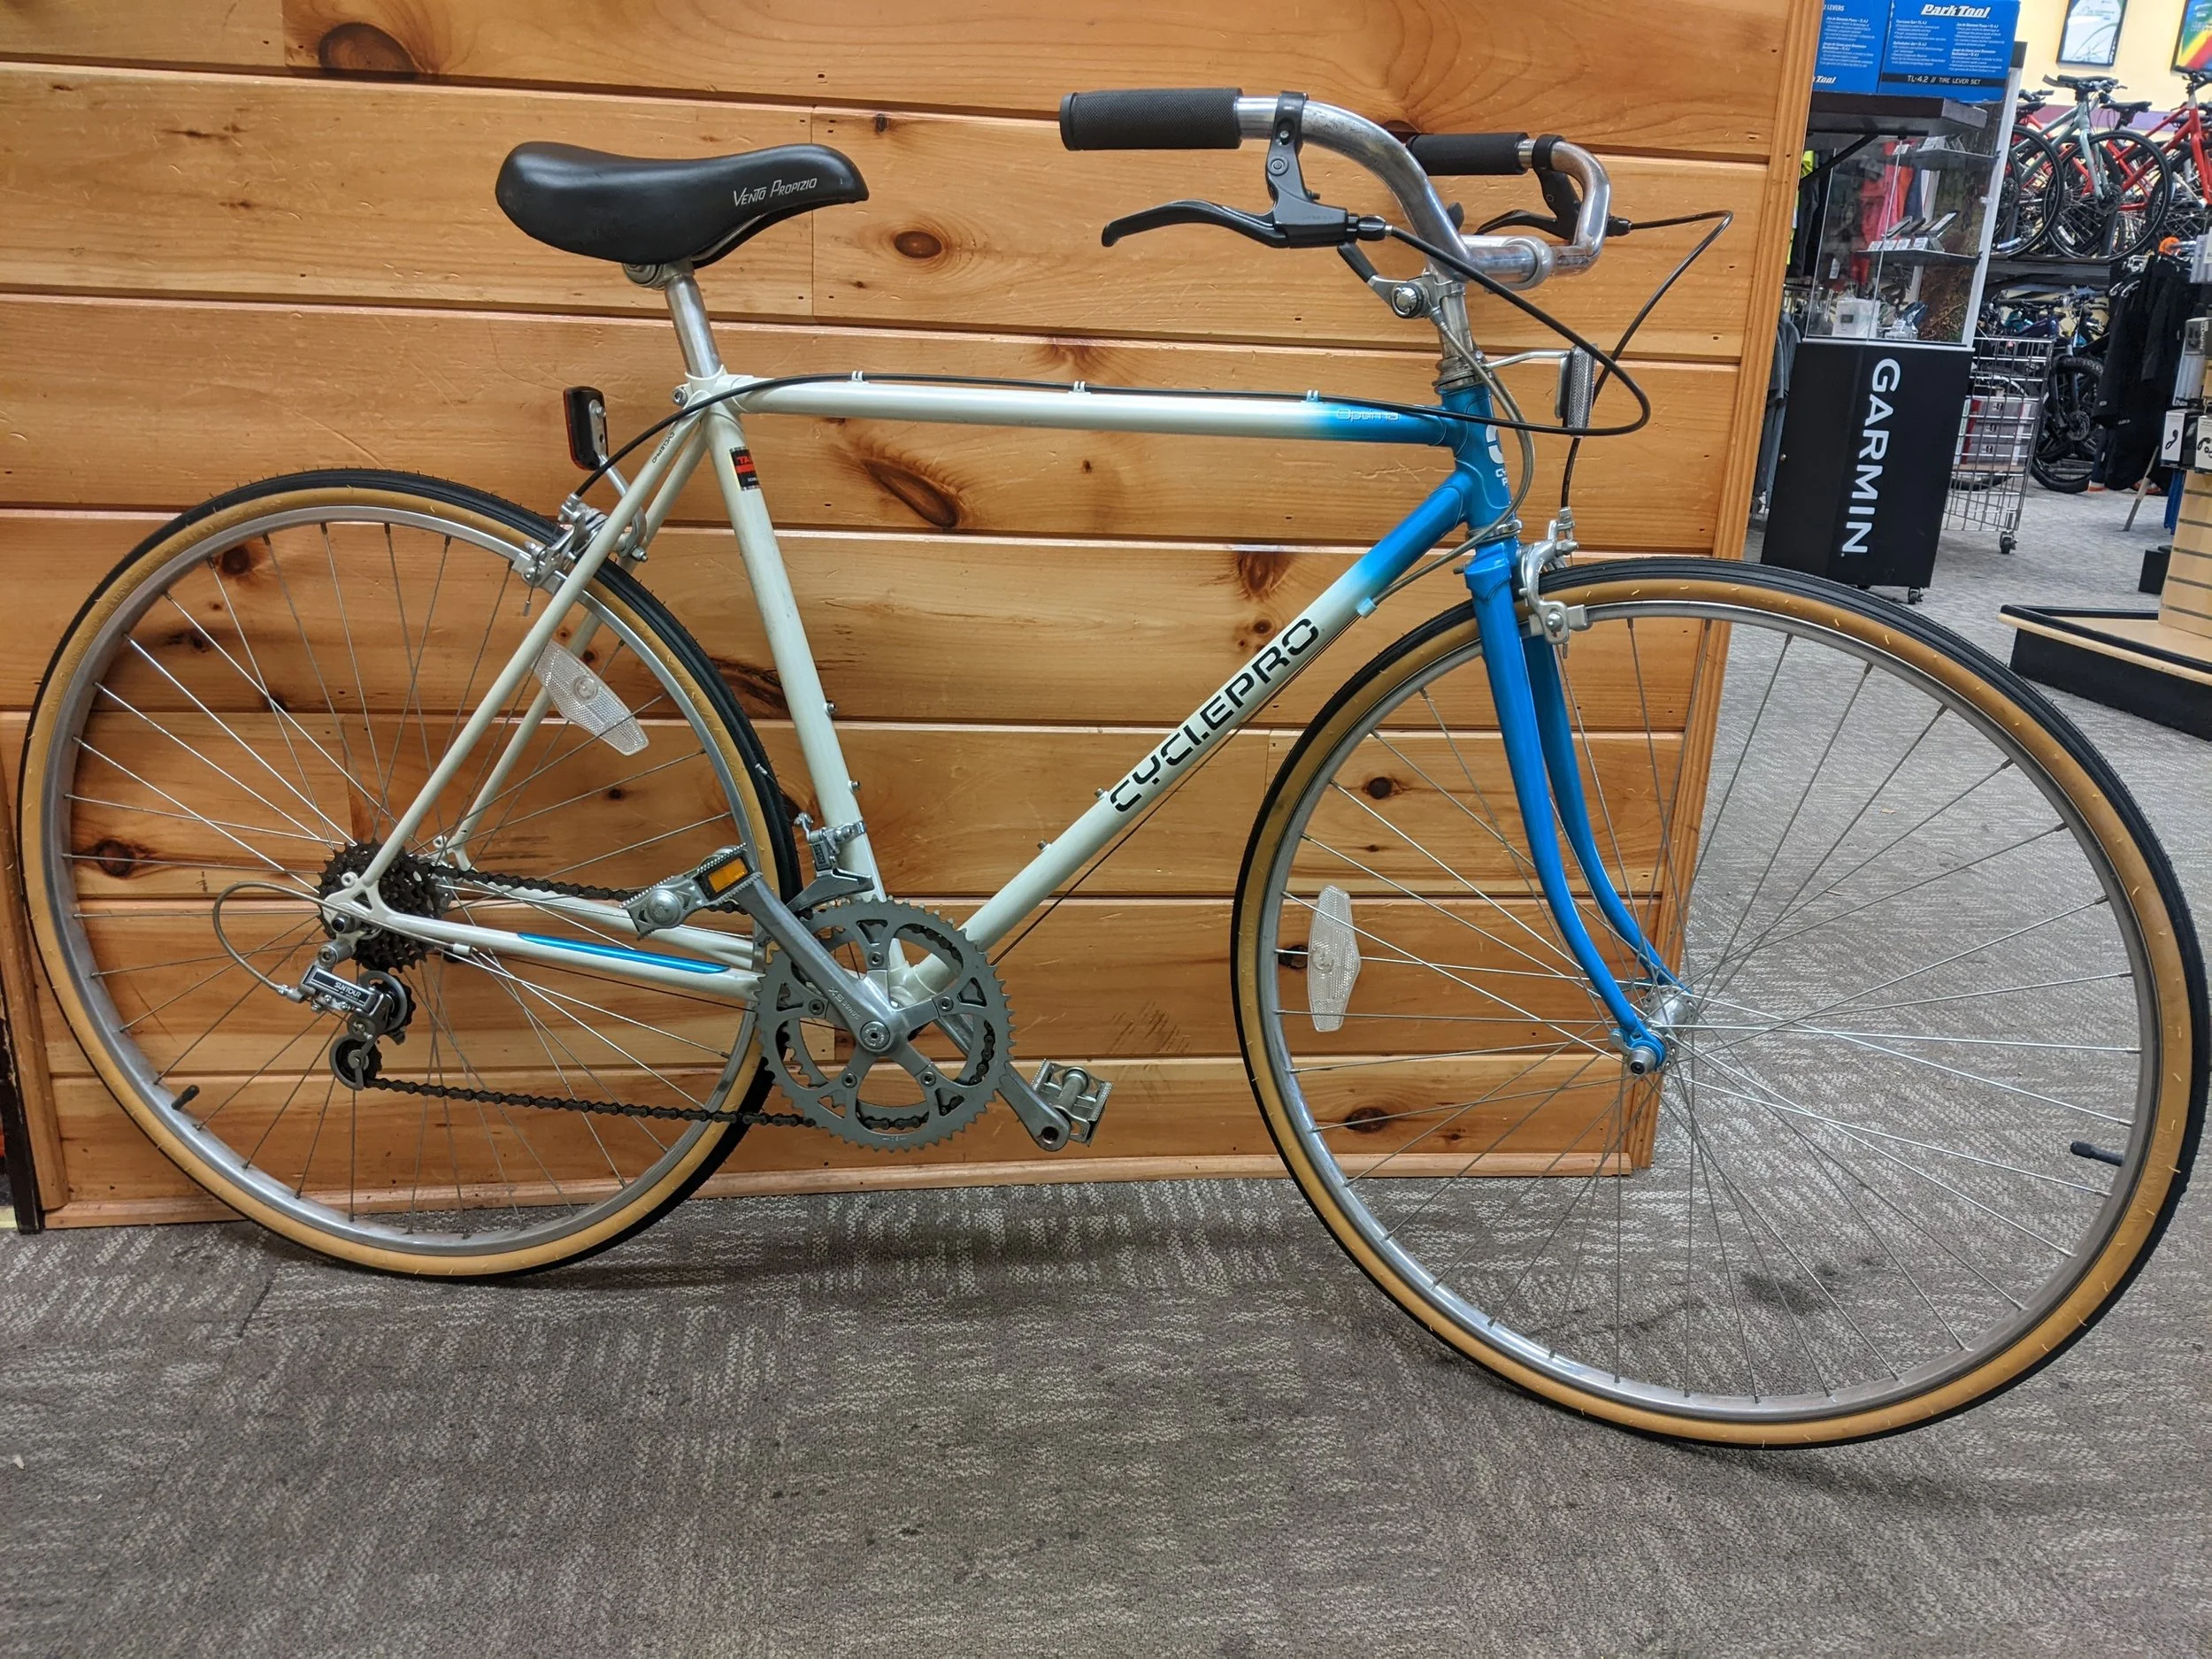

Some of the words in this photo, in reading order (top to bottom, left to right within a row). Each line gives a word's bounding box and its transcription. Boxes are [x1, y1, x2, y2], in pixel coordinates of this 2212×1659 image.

[1921, 4, 1957, 16] Park
[1957, 5, 1991, 18] Tool
[1337, 408, 1401, 422] Optima
[1842, 357, 1901, 554] GARMIN
[1110, 618, 1319, 812] CYCLEPRO
[334, 981, 362, 998] SUNTOUR
